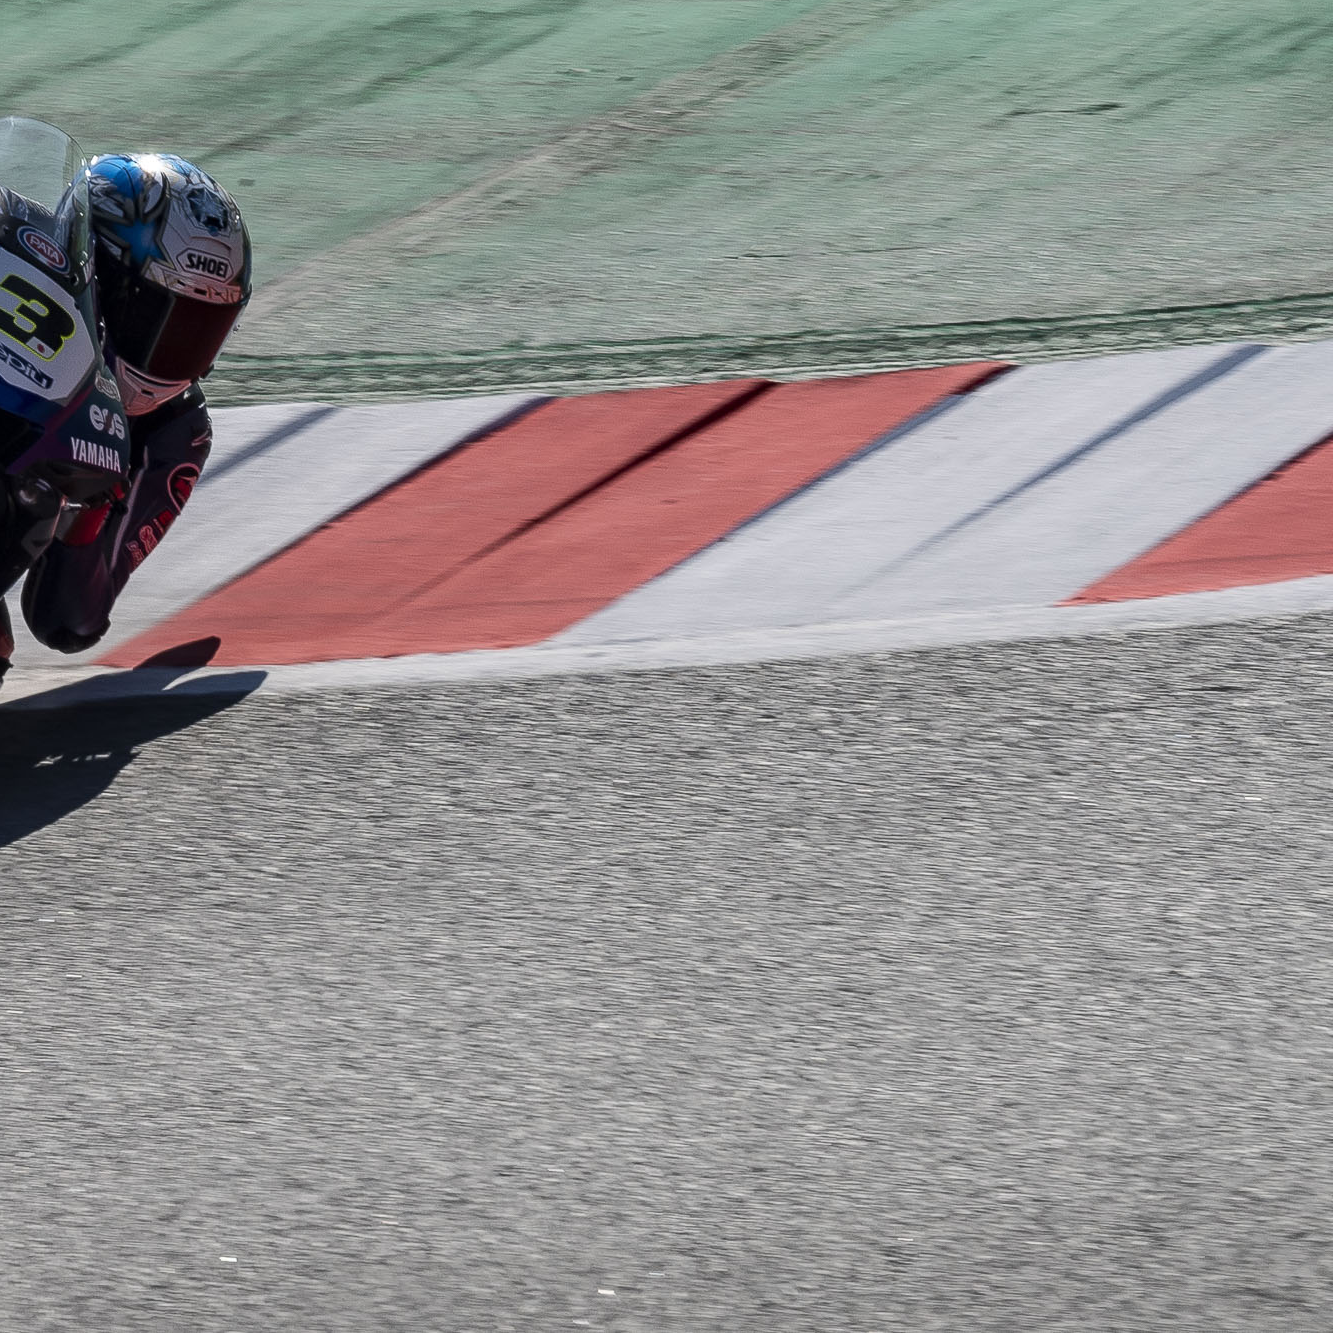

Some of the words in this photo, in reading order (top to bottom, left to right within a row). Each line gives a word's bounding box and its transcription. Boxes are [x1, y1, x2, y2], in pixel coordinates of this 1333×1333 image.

[29, 234, 61, 265] PATA
[186, 252, 228, 279] SHOEI
[71, 436, 121, 473] YAMAHA
